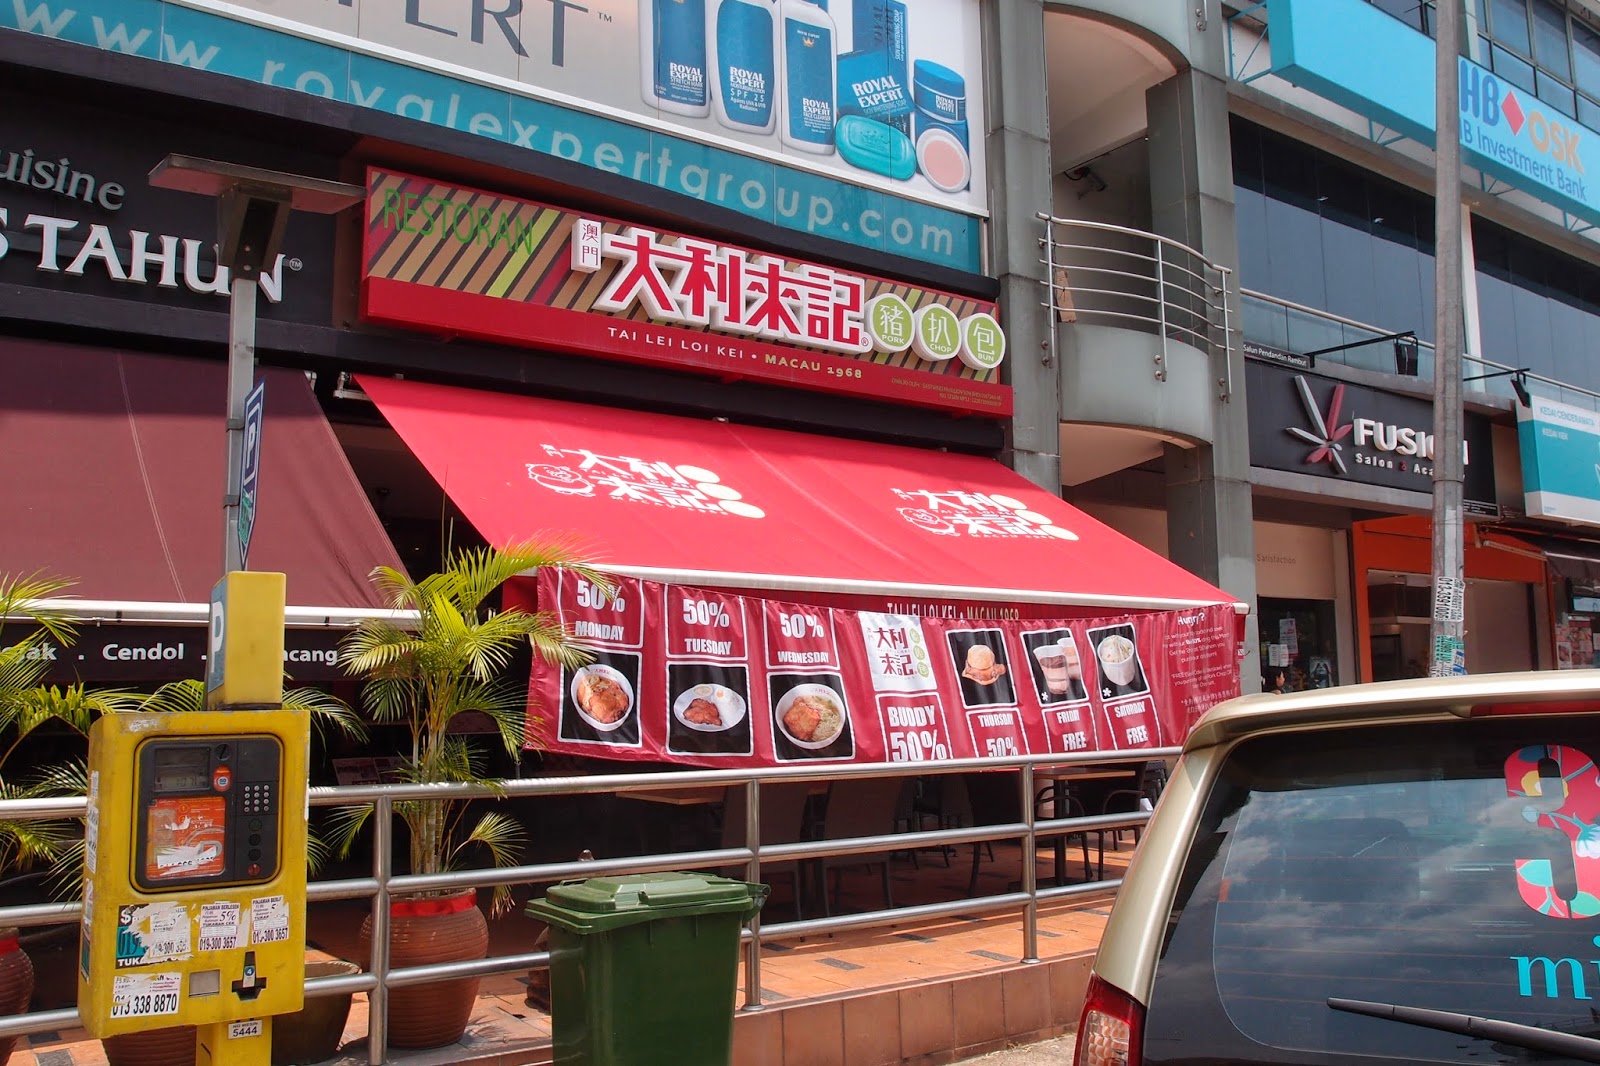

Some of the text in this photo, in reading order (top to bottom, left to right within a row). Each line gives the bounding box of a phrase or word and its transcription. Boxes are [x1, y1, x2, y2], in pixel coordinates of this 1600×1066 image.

[669, 62, 702, 76] ROYAL
[670, 71, 703, 82] EXPERT
[729, 66, 764, 81] ROYAL
[729, 75, 765, 89] EXPERT
[852, 75, 900, 97] ROYAL
[803, 97, 830, 110] ROYAL
[858, 88, 903, 108] EXPERT
[803, 106, 830, 116] EXPERT
[1528, 111, 1584, 174] OSK
[1477, 126, 1554, 185] Investment
[1556, 167, 1587, 201] Bank
[384, 187, 533, 255] RESTORAN
[581, 222, 599, 266] 澳門
[607, 327, 863, 380] TAI LEI LOI KEI MACAU 1968
[882, 334, 995, 362] PORK CHOP BUN
[1259, 348, 1287, 361] Pendandan
[1288, 355, 1307, 367] Rambut
[1354, 418, 1469, 465] FUSI
[1355, 452, 1393, 469] Salon
[1256, 553, 1297, 565] Satisfaction
[577, 579, 626, 613] 50%
[683, 598, 731, 628] 50%
[574, 620, 625, 641] MONDAY
[779, 612, 825, 639] 50%
[102, 642, 184, 661] Cendol
[684, 638, 732, 656] TUESDAY
[777, 651, 829, 665] WEDNESDAY
[887, 705, 935, 727] BUDDY
[1114, 701, 1146, 718] SATURDAY
[890, 728, 947, 762] 50%
[1062, 731, 1087, 751] FREE
[1126, 725, 1149, 746] FREE
[986, 736, 1019, 758] 50%
[220, 910, 237, 922] 5%
[199, 937, 222, 951] 019-300
[222, 936, 237, 949] 3657
[275, 927, 288, 941] 3657
[133, 994, 152, 1014] 338
[153, 993, 178, 1013] 8870
[232, 1026, 258, 1037] 5444
